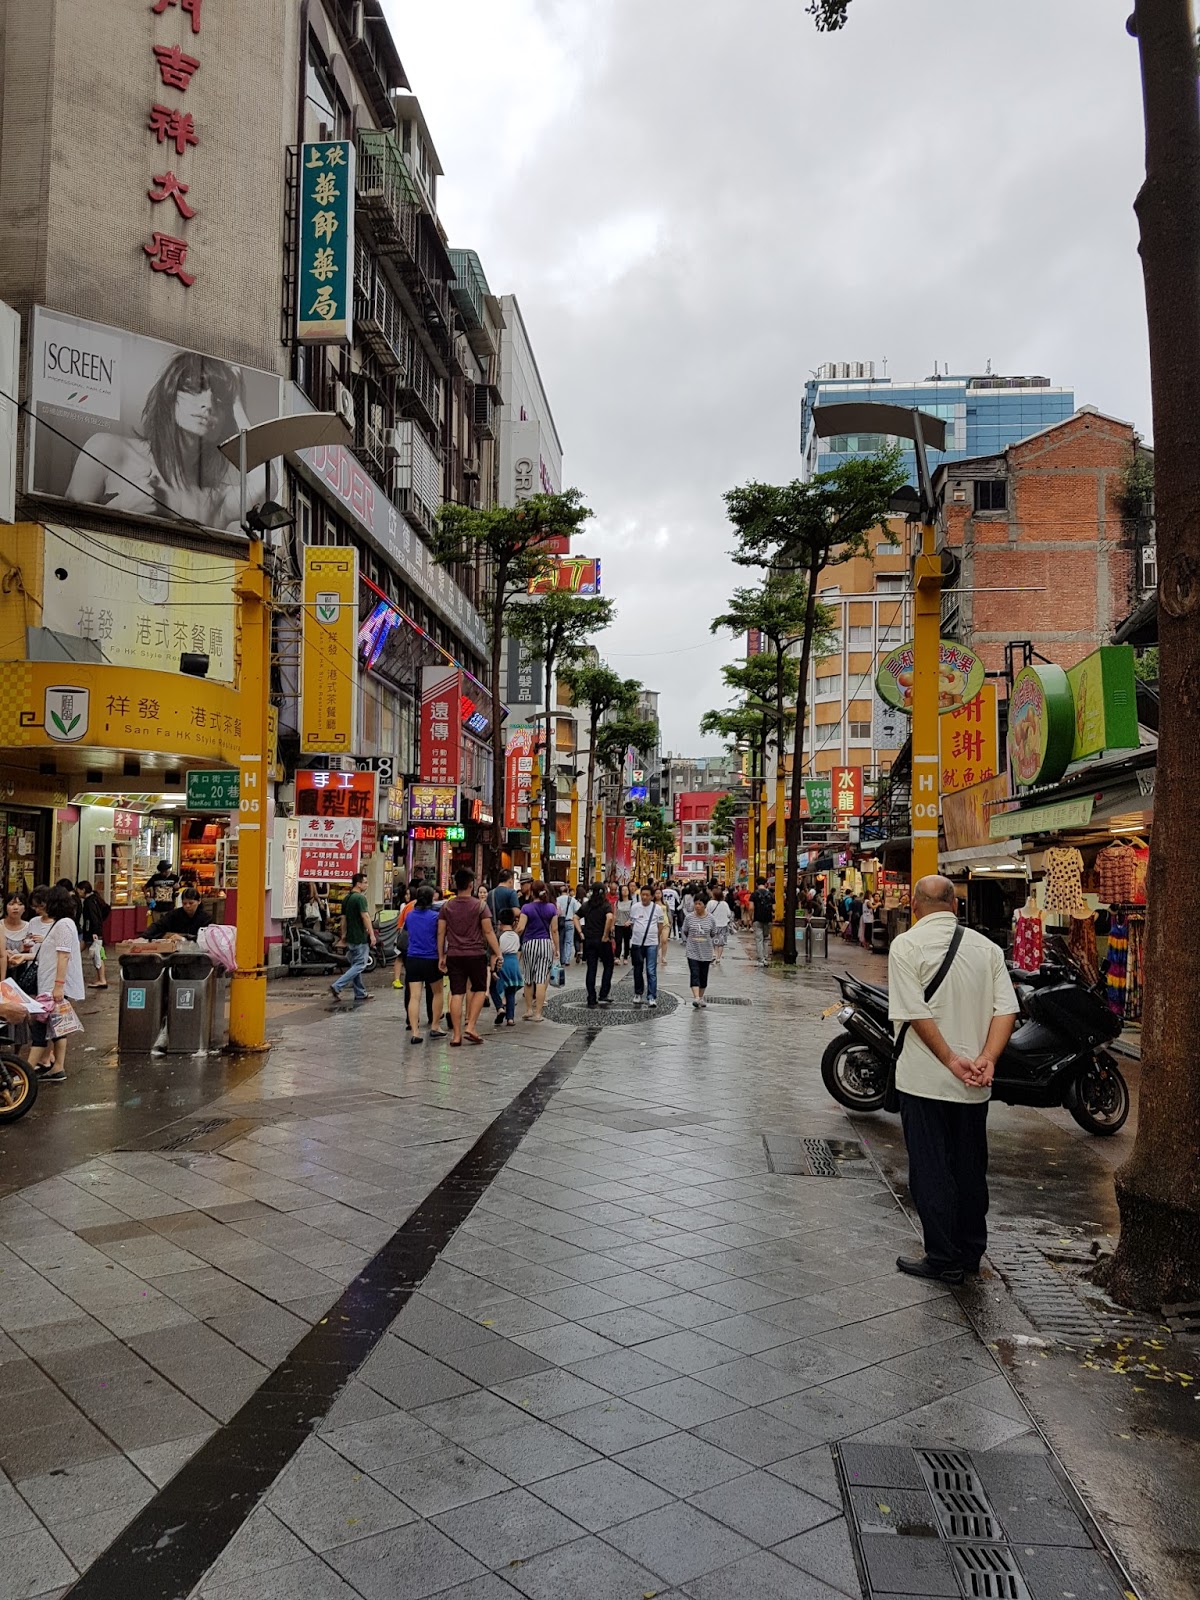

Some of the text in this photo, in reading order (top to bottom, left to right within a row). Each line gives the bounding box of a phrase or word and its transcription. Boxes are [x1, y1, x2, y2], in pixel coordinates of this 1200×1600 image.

[48, 342, 113, 385] SCREEN
[885, 643, 976, 678] 三和水果
[430, 701, 449, 741] 遠傳
[124, 724, 150, 735] San
[156, 727, 171, 737] Fa
[176, 730, 191, 740] HK
[195, 733, 216, 746] Style
[244, 772, 257, 788] H
[314, 772, 354, 788] 手工
[918, 774, 933, 791] H
[210, 785, 224, 798] 20
[240, 799, 260, 812] 05
[915, 804, 938, 818] 06
